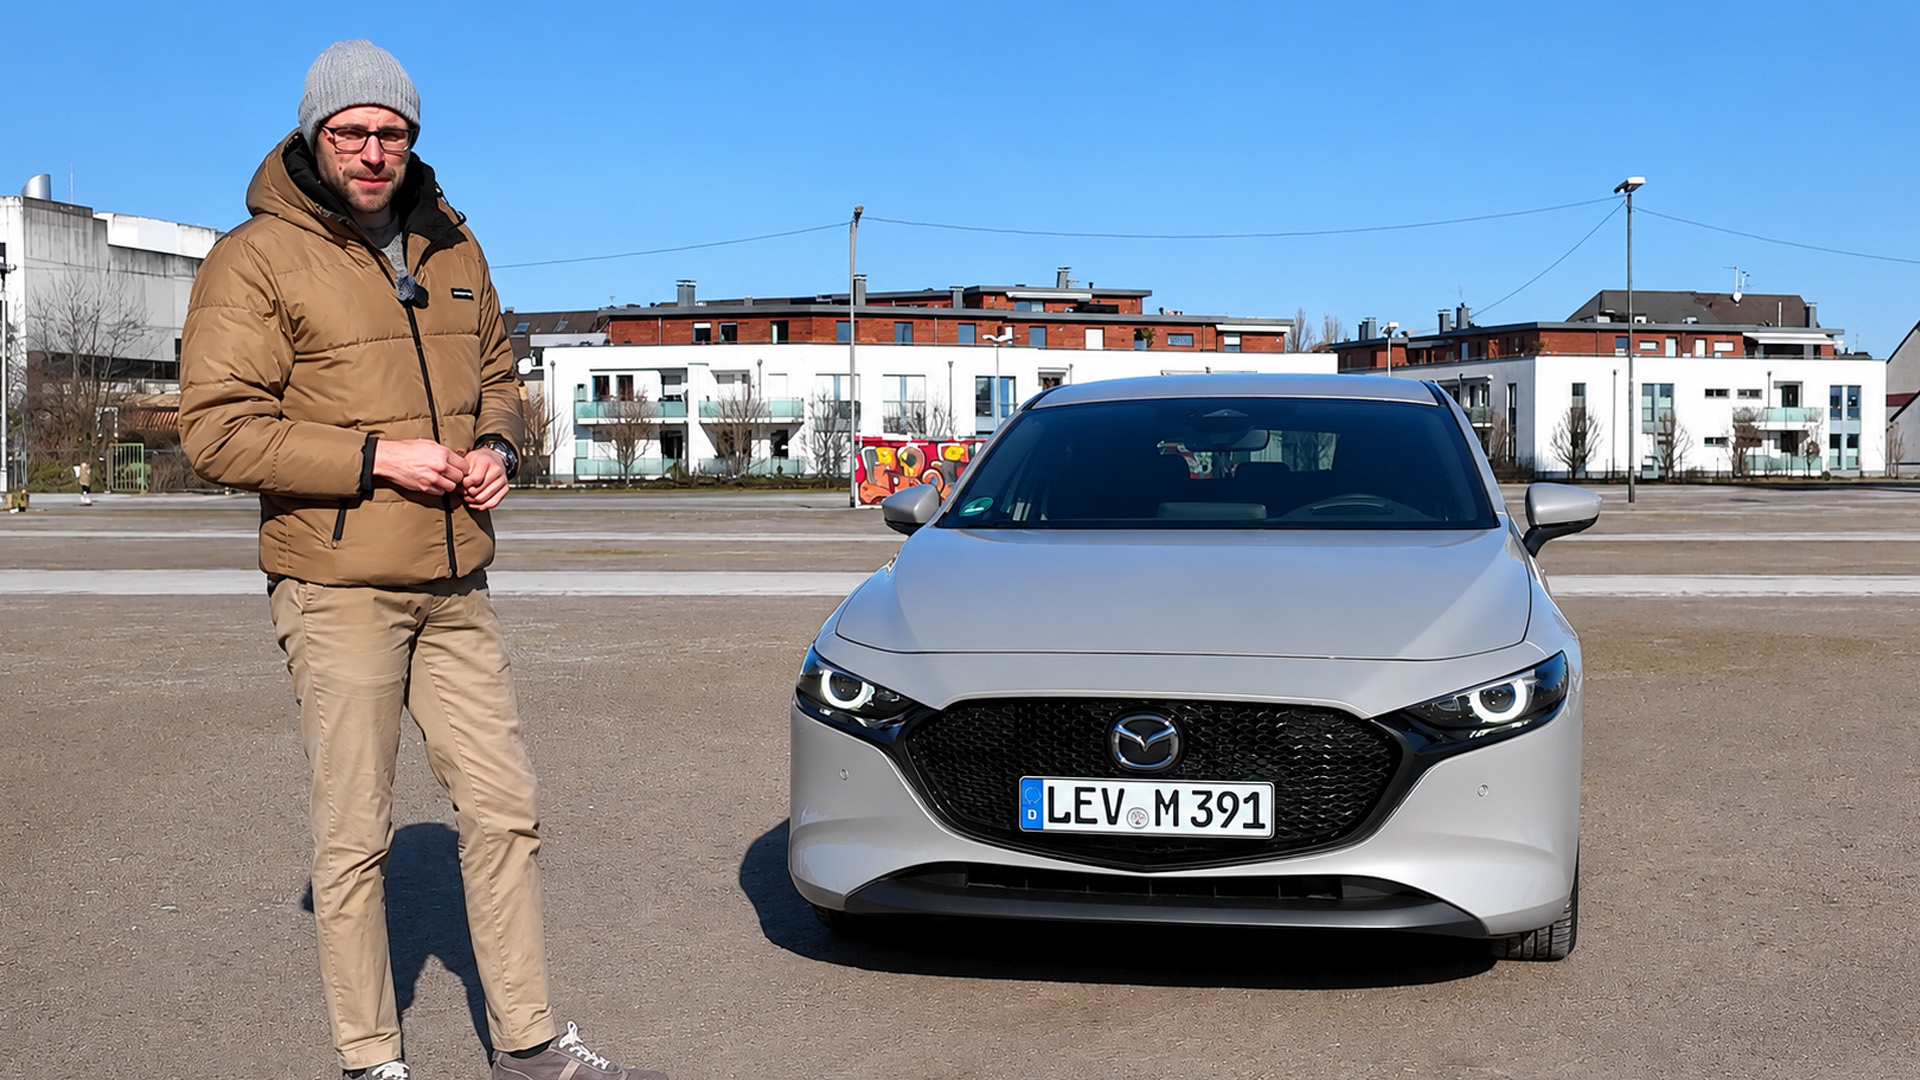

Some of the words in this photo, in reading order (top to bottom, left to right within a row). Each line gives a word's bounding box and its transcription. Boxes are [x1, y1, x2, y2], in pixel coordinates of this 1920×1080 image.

[1027, 809, 1037, 820] D
[1047, 786, 1125, 825] LEV
[1154, 789, 1180, 827] M
[1190, 790, 1266, 829] 391
